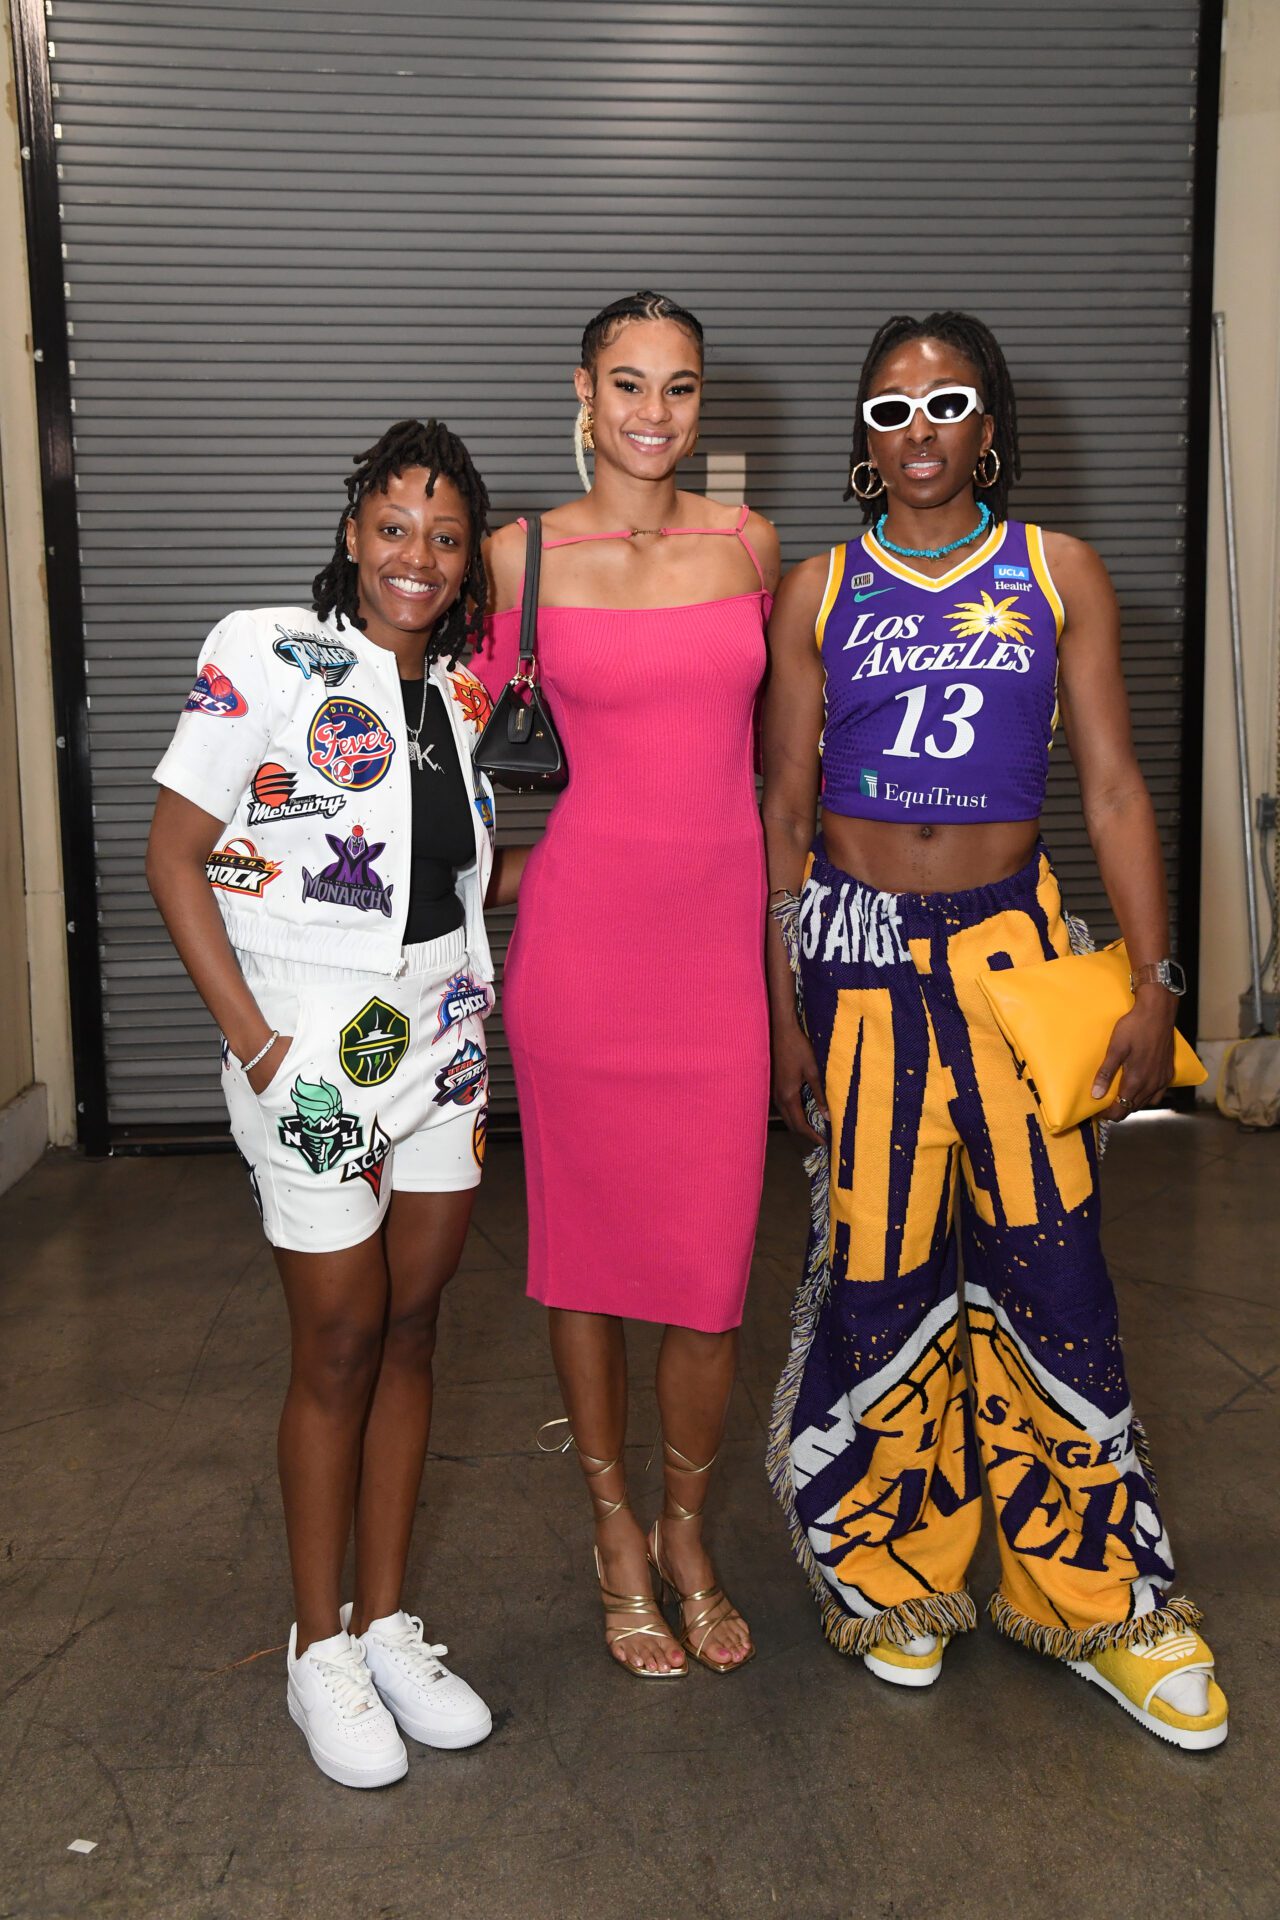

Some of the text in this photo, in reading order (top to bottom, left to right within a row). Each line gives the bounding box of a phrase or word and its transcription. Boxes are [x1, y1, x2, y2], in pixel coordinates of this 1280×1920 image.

[998, 568, 1025, 578] UCLA
[842, 612, 925, 651] LOS
[851, 636, 1035, 681] ANGELES
[323, 705, 374, 729] IDIANA
[882, 682, 984, 759] 13
[311, 721, 394, 767] Fever
[884, 782, 988, 809] EquiTrust
[249, 796, 346, 824] Mercury
[206, 864, 269, 891] HOCK
[302, 866, 394, 918] MONARCHS
[284, 1130, 302, 1146] N
